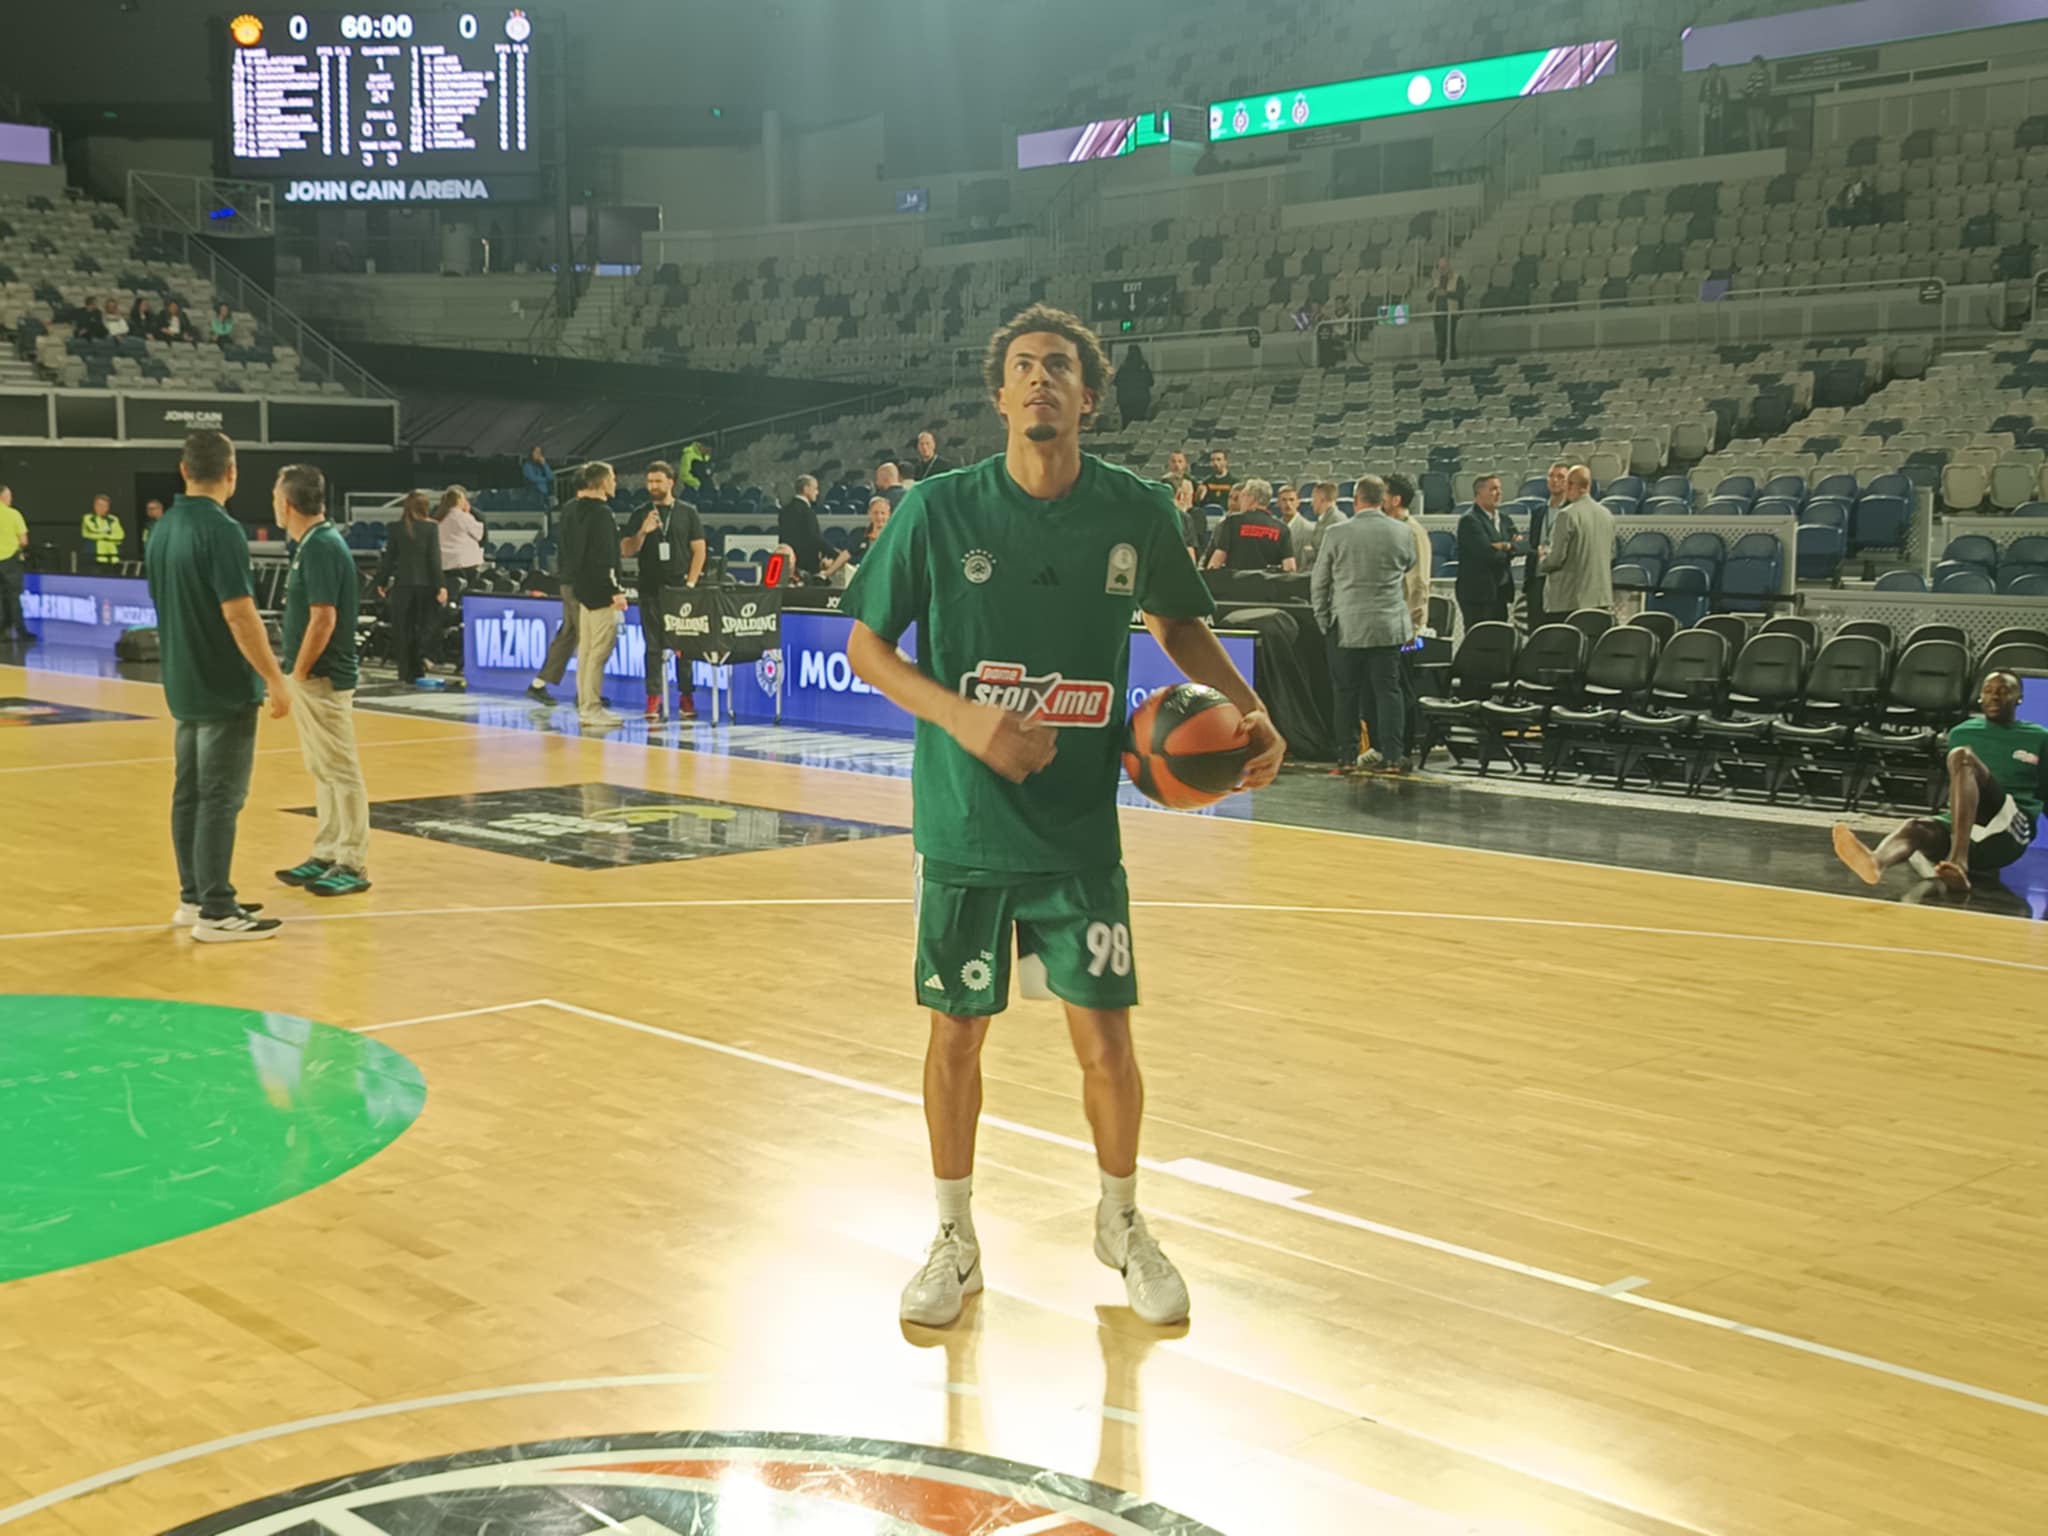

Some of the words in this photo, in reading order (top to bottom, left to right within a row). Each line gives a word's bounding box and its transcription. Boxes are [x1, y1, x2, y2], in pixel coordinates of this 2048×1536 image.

[289, 15, 308, 40] 0
[341, 15, 413, 39] 60:00
[459, 14, 479, 39] 0
[376, 57, 384, 71] 1
[370, 91, 389, 104] 24
[361, 122, 373, 137] 0
[385, 122, 397, 137] 0
[362, 152, 373, 167] 3
[386, 152, 398, 167] 3
[285, 181, 347, 201] JOHN
[350, 180, 405, 200] CAIN
[409, 179, 488, 199] ARENA
[164, 410, 194, 421] JOHN
[196, 411, 223, 421] CAIN
[1240, 524, 1280, 542] ESPN
[764, 553, 784, 588] 0
[664, 613, 710, 634] SPALDING
[721, 613, 777, 634] SPALDING
[475, 610, 547, 669] VAŽNO
[1087, 921, 1131, 977] 98
